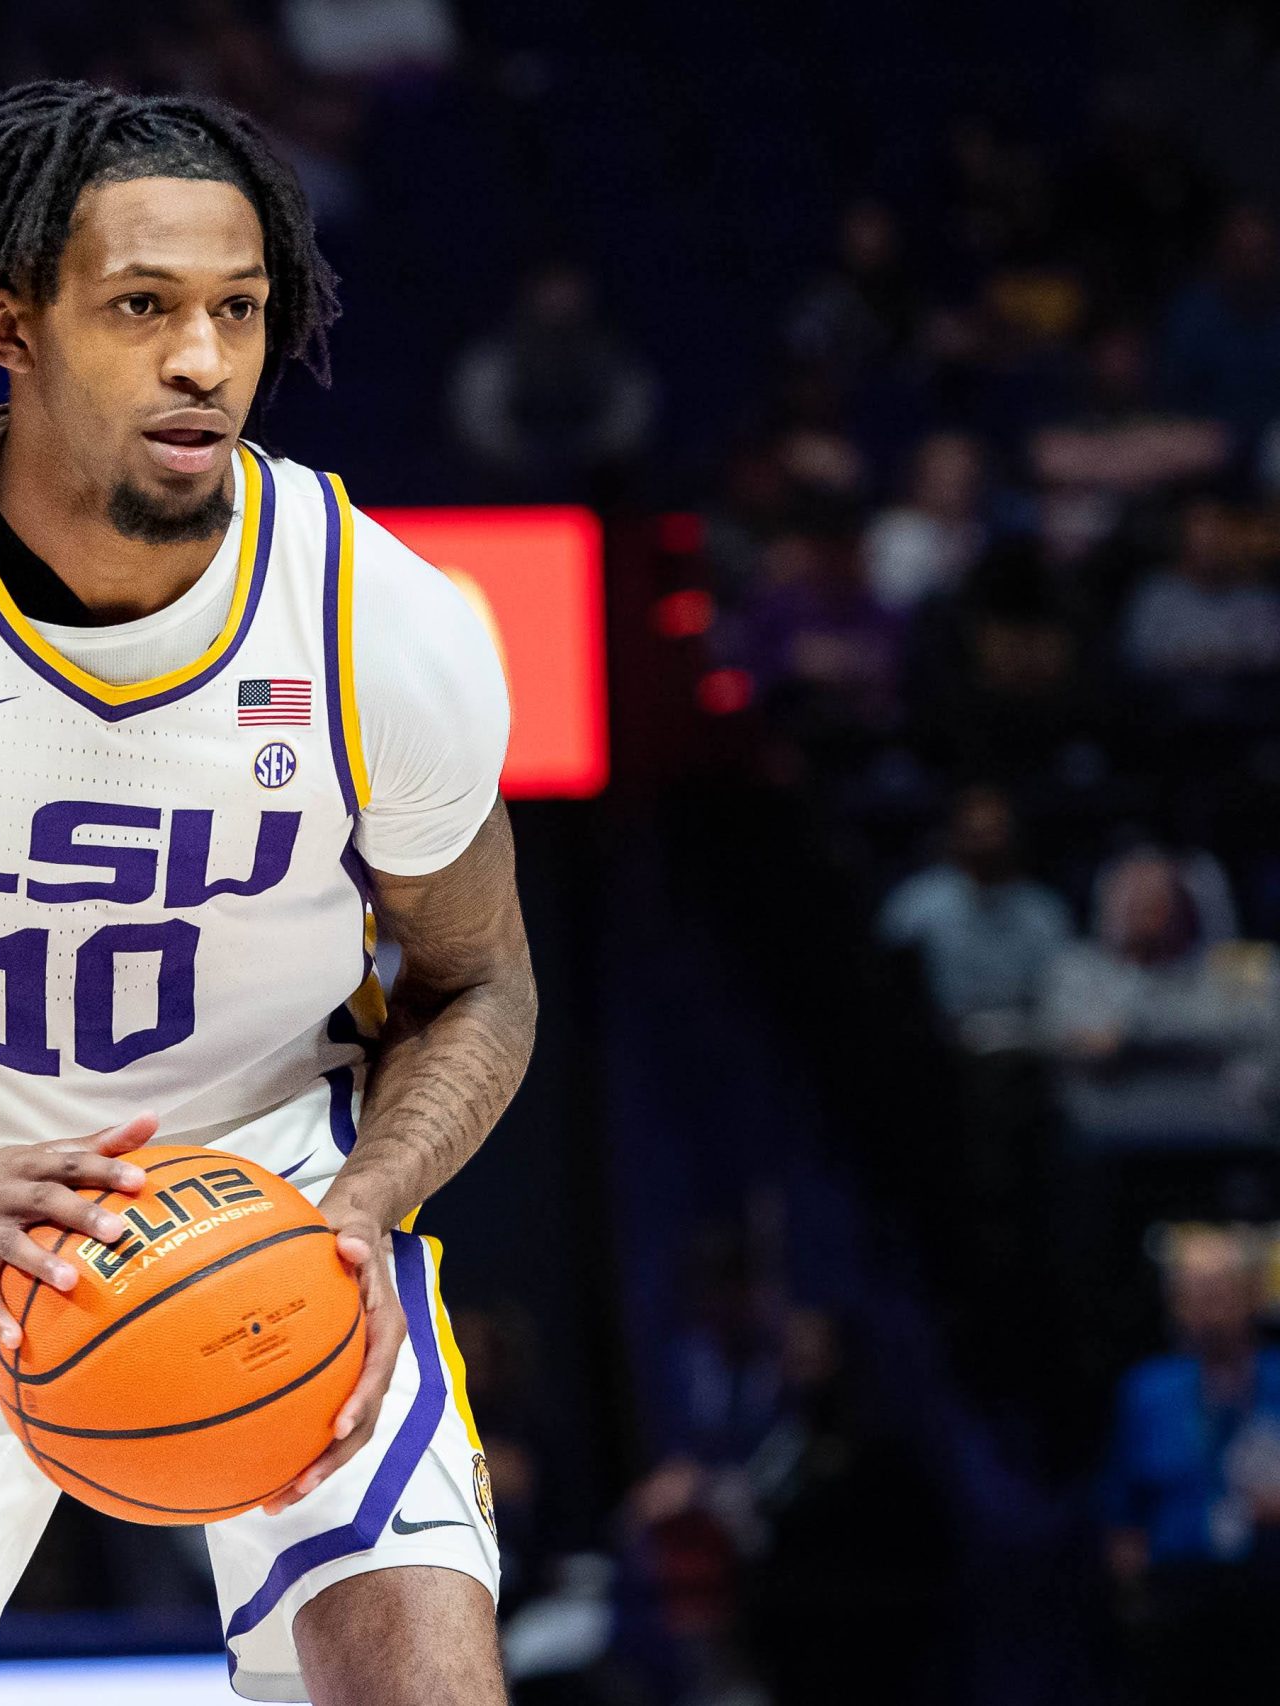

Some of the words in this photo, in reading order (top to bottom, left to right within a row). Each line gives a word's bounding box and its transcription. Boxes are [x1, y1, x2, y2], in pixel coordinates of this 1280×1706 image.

[256, 744, 295, 787] SEC
[77, 1167, 266, 1282] ELITE
[114, 1201, 274, 1295] CAMPIONSHIP
